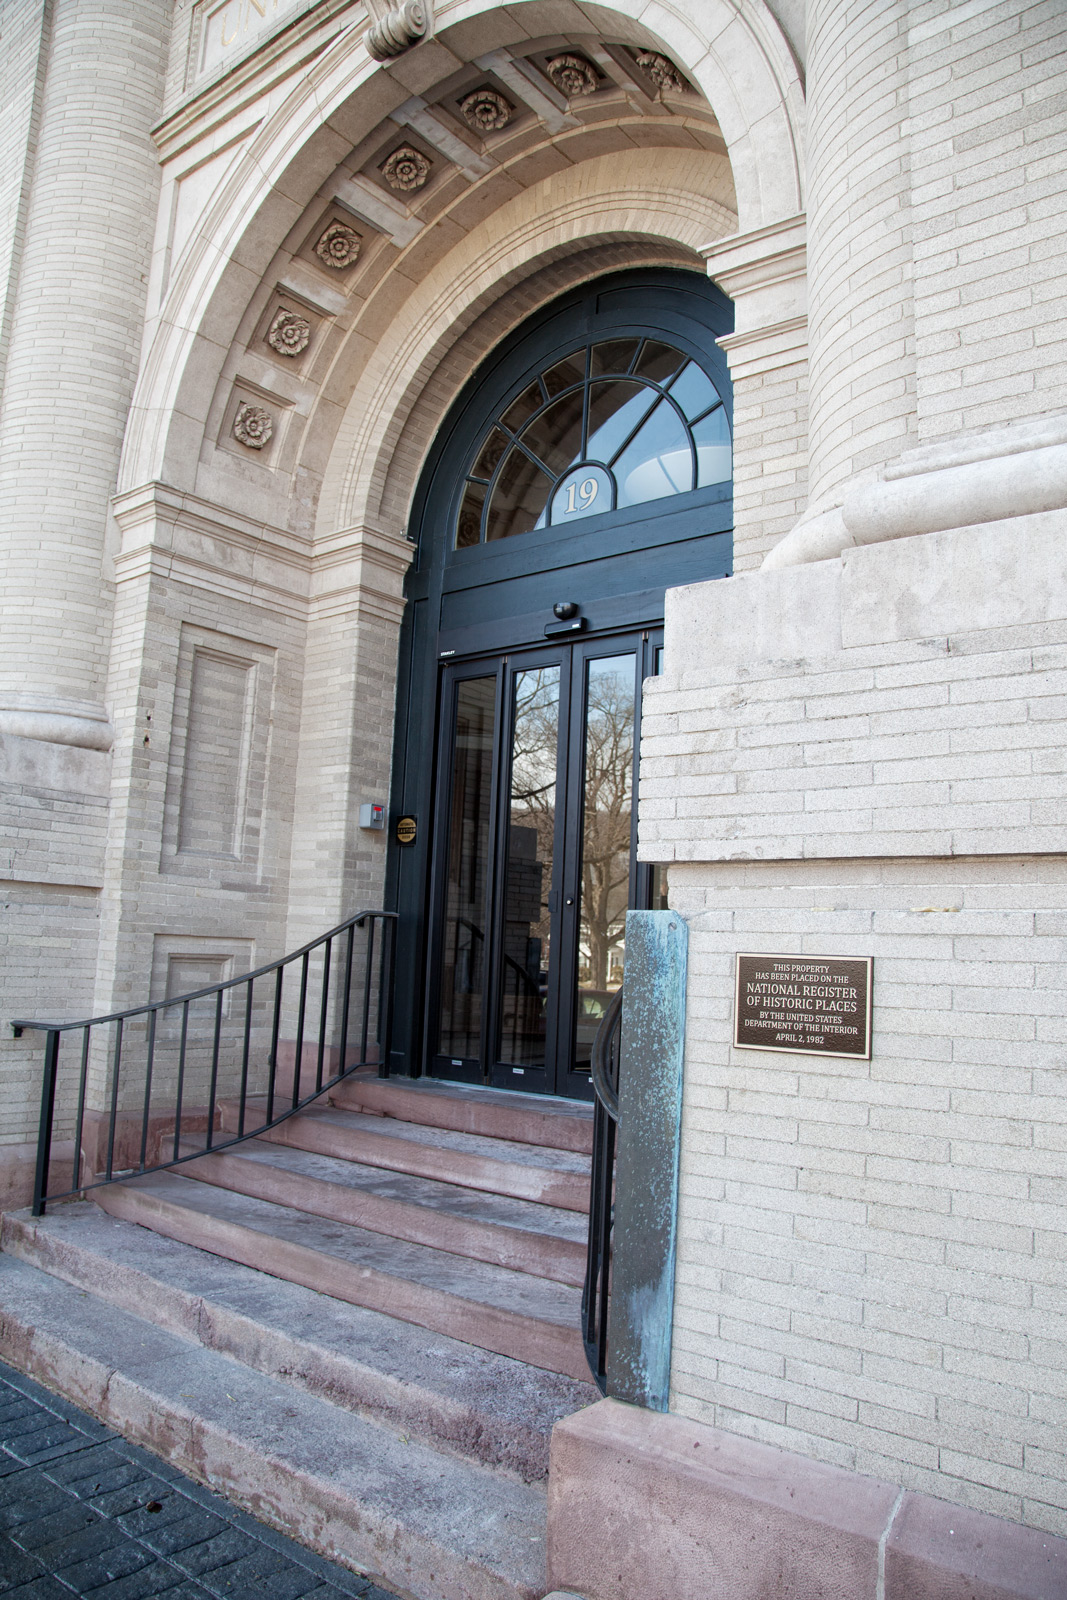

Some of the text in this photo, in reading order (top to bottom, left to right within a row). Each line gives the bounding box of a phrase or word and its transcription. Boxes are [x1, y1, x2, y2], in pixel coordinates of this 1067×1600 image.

[564, 477, 599, 515] 19
[773, 963, 830, 974] THIS PROPERTY
[755, 972, 849, 984] HAS BEEN PLACED ON THE
[746, 982, 858, 999] NATIONAL REGISTER
[746, 995, 857, 1013] OF HISTORIC PLACES
[759, 1011, 843, 1024] BY THE UNITED STATES
[744, 1019, 858, 1035] DEPARTMENT OF THE INTERIOR
[775, 1033, 825, 1044] APRIL 2, 1982
